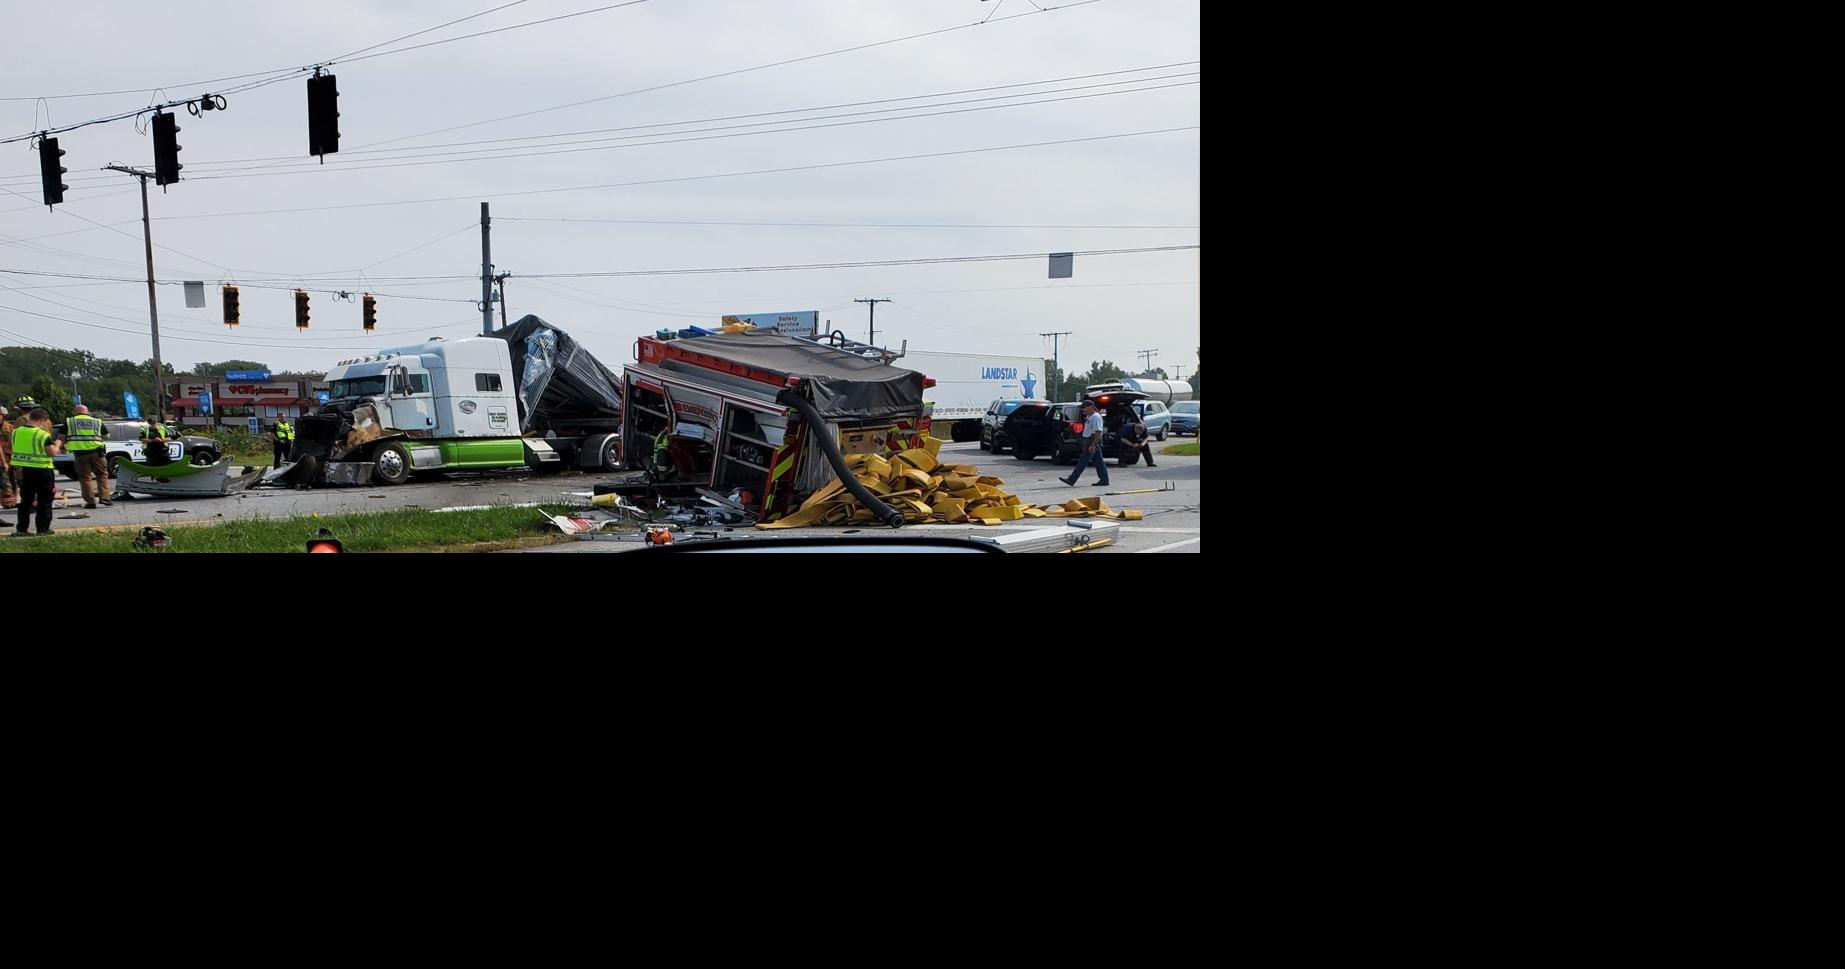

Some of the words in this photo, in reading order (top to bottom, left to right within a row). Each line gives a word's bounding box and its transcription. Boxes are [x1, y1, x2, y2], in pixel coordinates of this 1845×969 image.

[981, 366, 1018, 380] LANDSTAR
[236, 384, 256, 395] CVS
[255, 385, 289, 397] pharmacy
